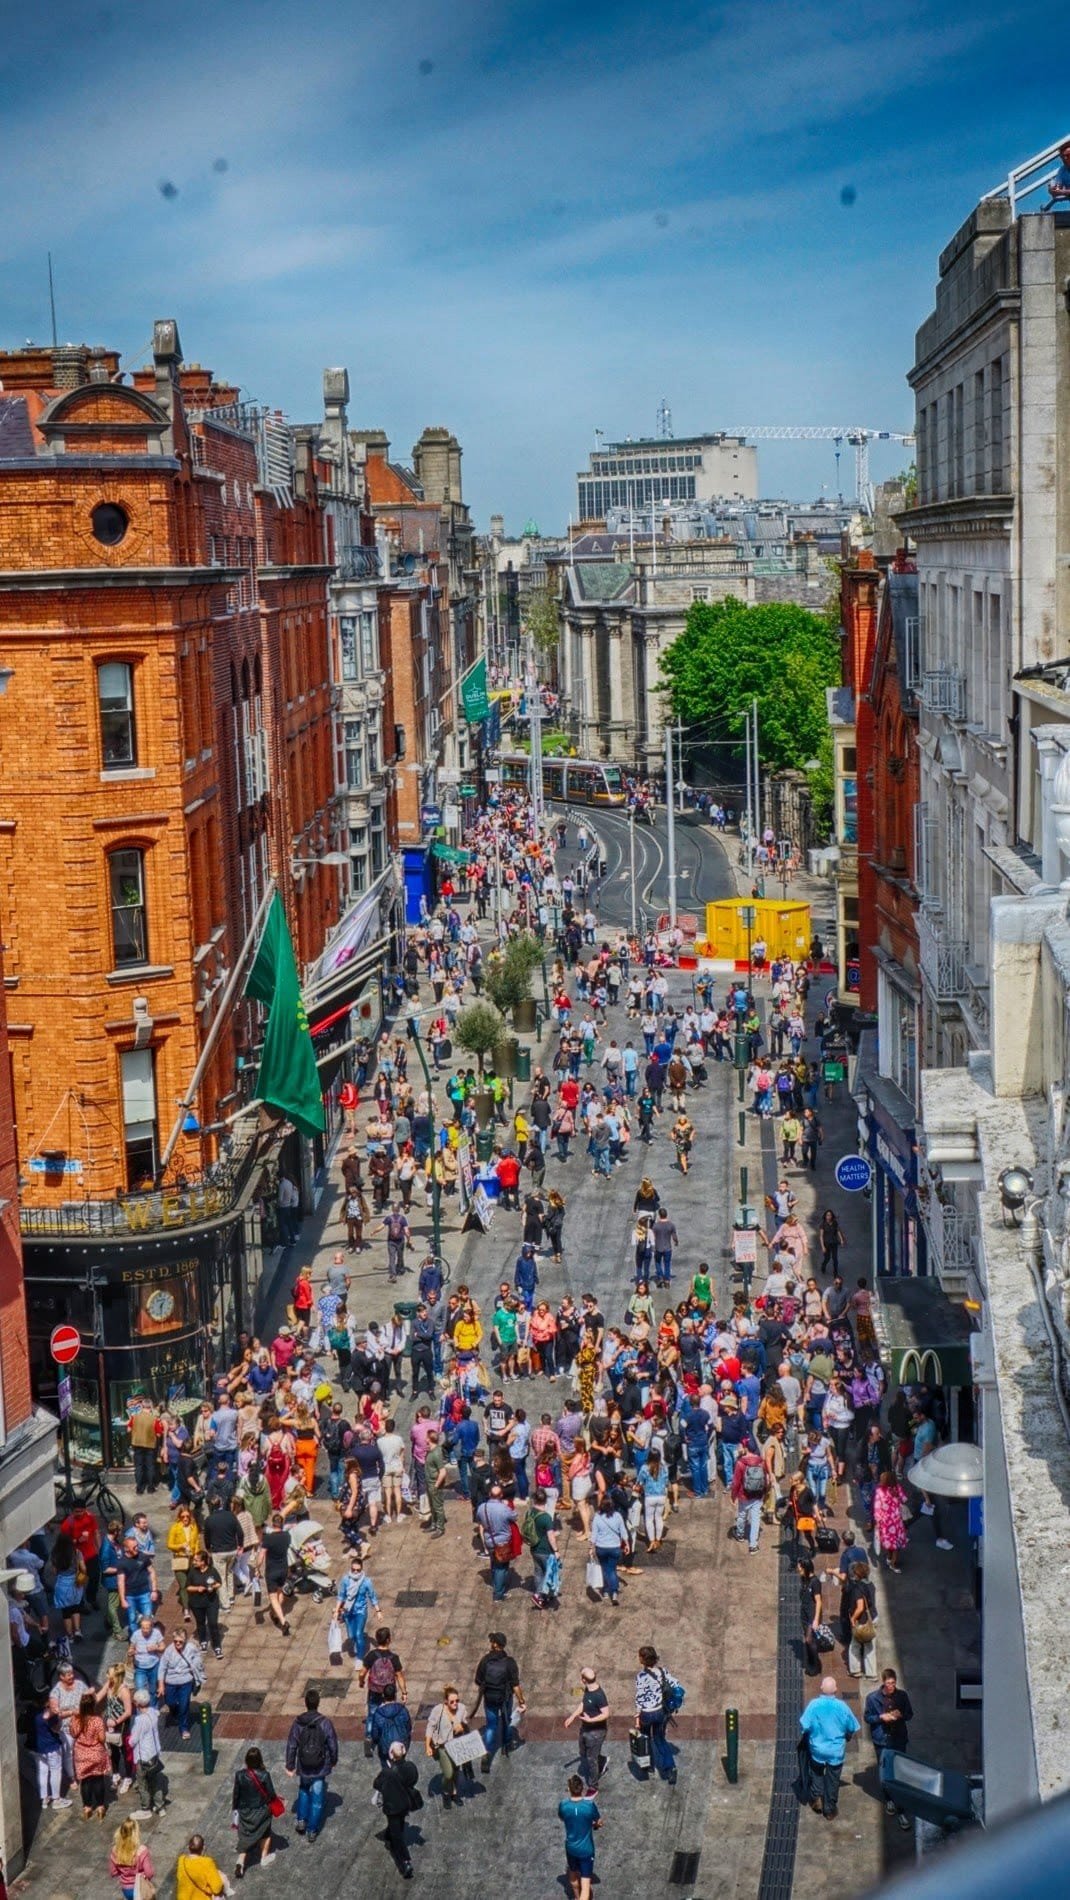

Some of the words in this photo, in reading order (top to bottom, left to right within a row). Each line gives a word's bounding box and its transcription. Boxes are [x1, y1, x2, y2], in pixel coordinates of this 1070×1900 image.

[841, 1163, 865, 1173] HEALTH
[839, 1172, 869, 1182] MATTERS
[120, 1187, 220, 1230] WEIR
